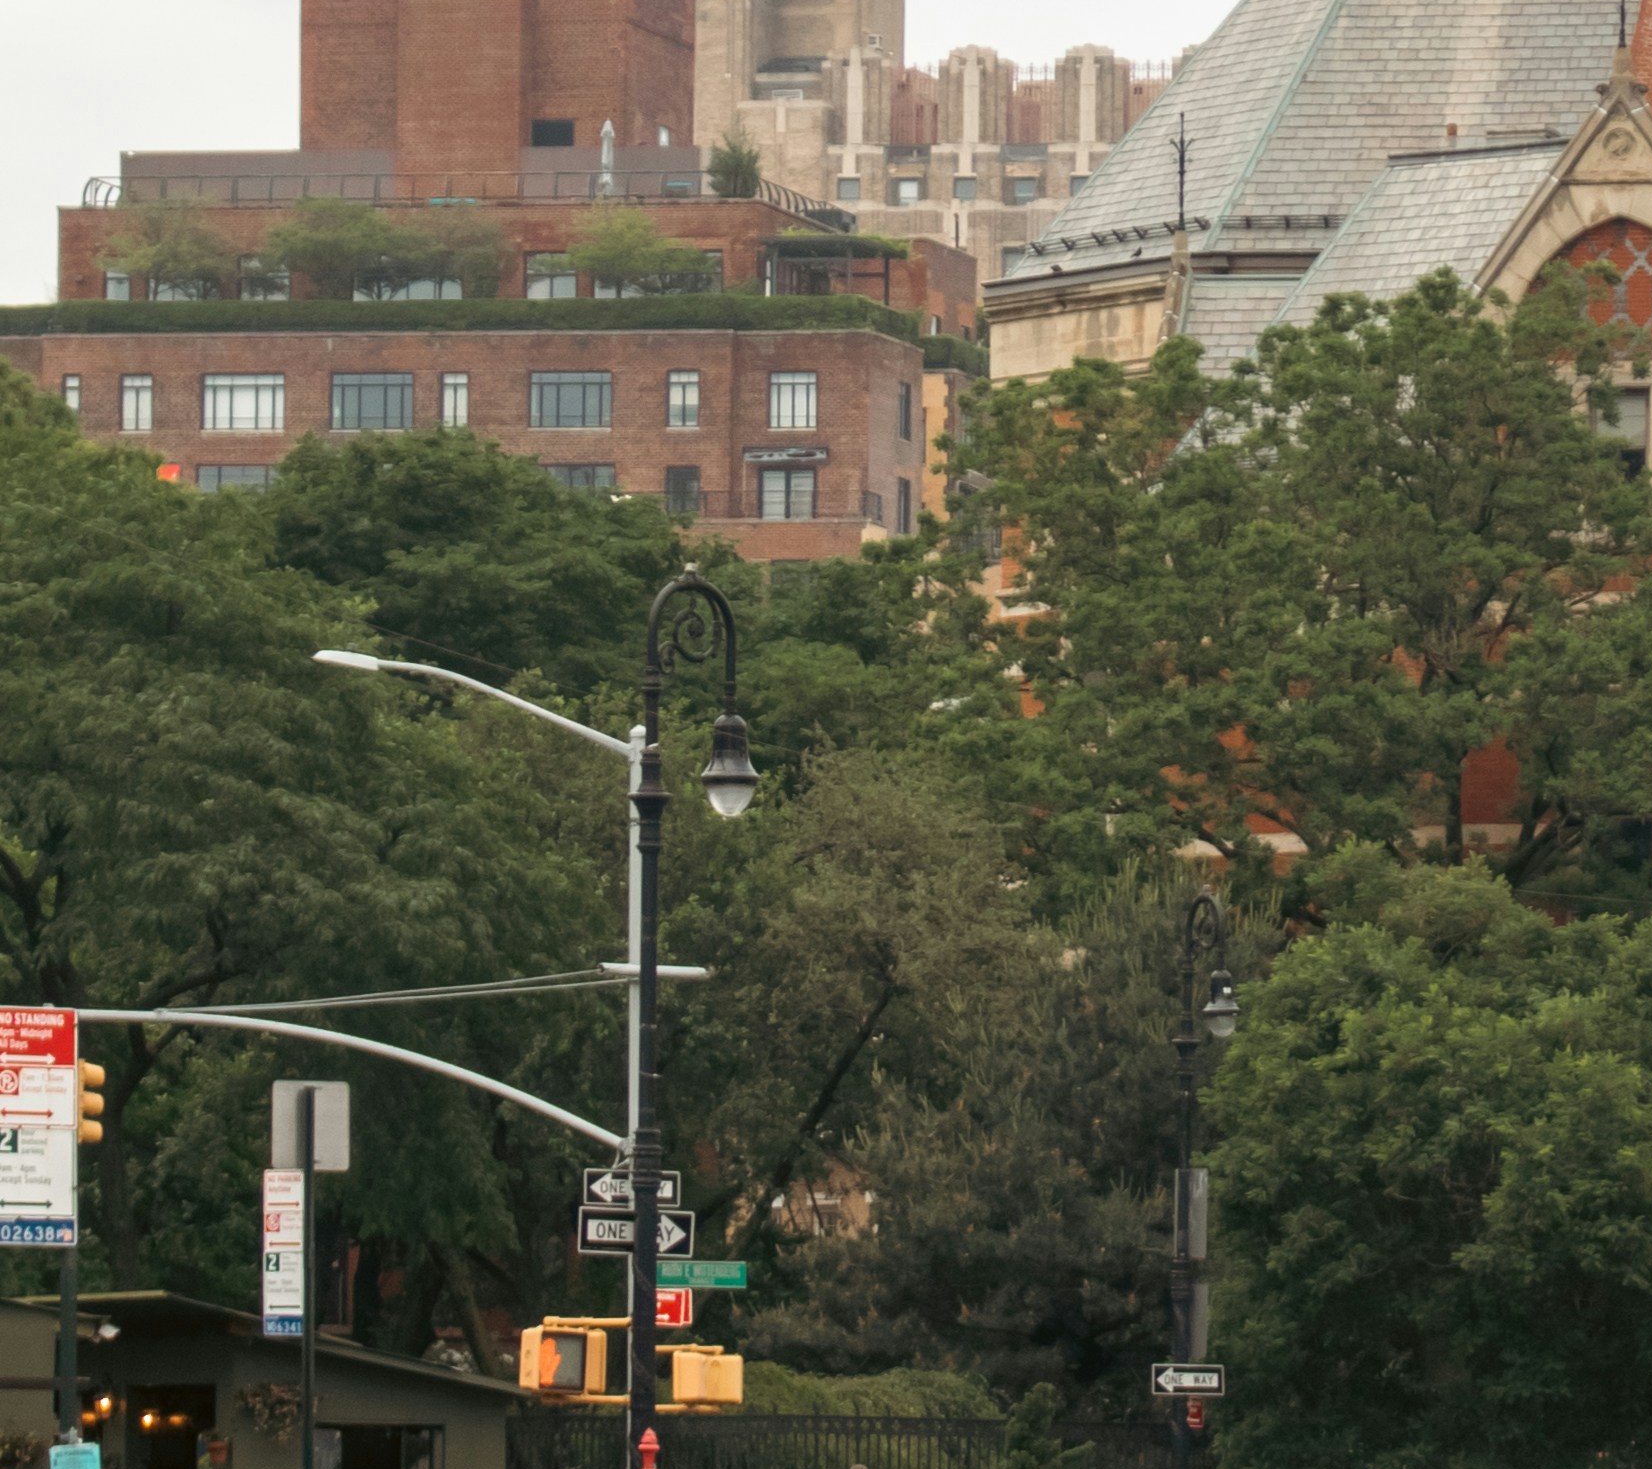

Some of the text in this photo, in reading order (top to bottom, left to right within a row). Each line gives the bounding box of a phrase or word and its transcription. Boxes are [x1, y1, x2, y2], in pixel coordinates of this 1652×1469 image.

[14, 1013, 65, 1027] STANDING
[600, 1181, 626, 1194] ONE
[595, 1222, 628, 1239] ONE
[1164, 1373, 1214, 1385] ONE WAY
